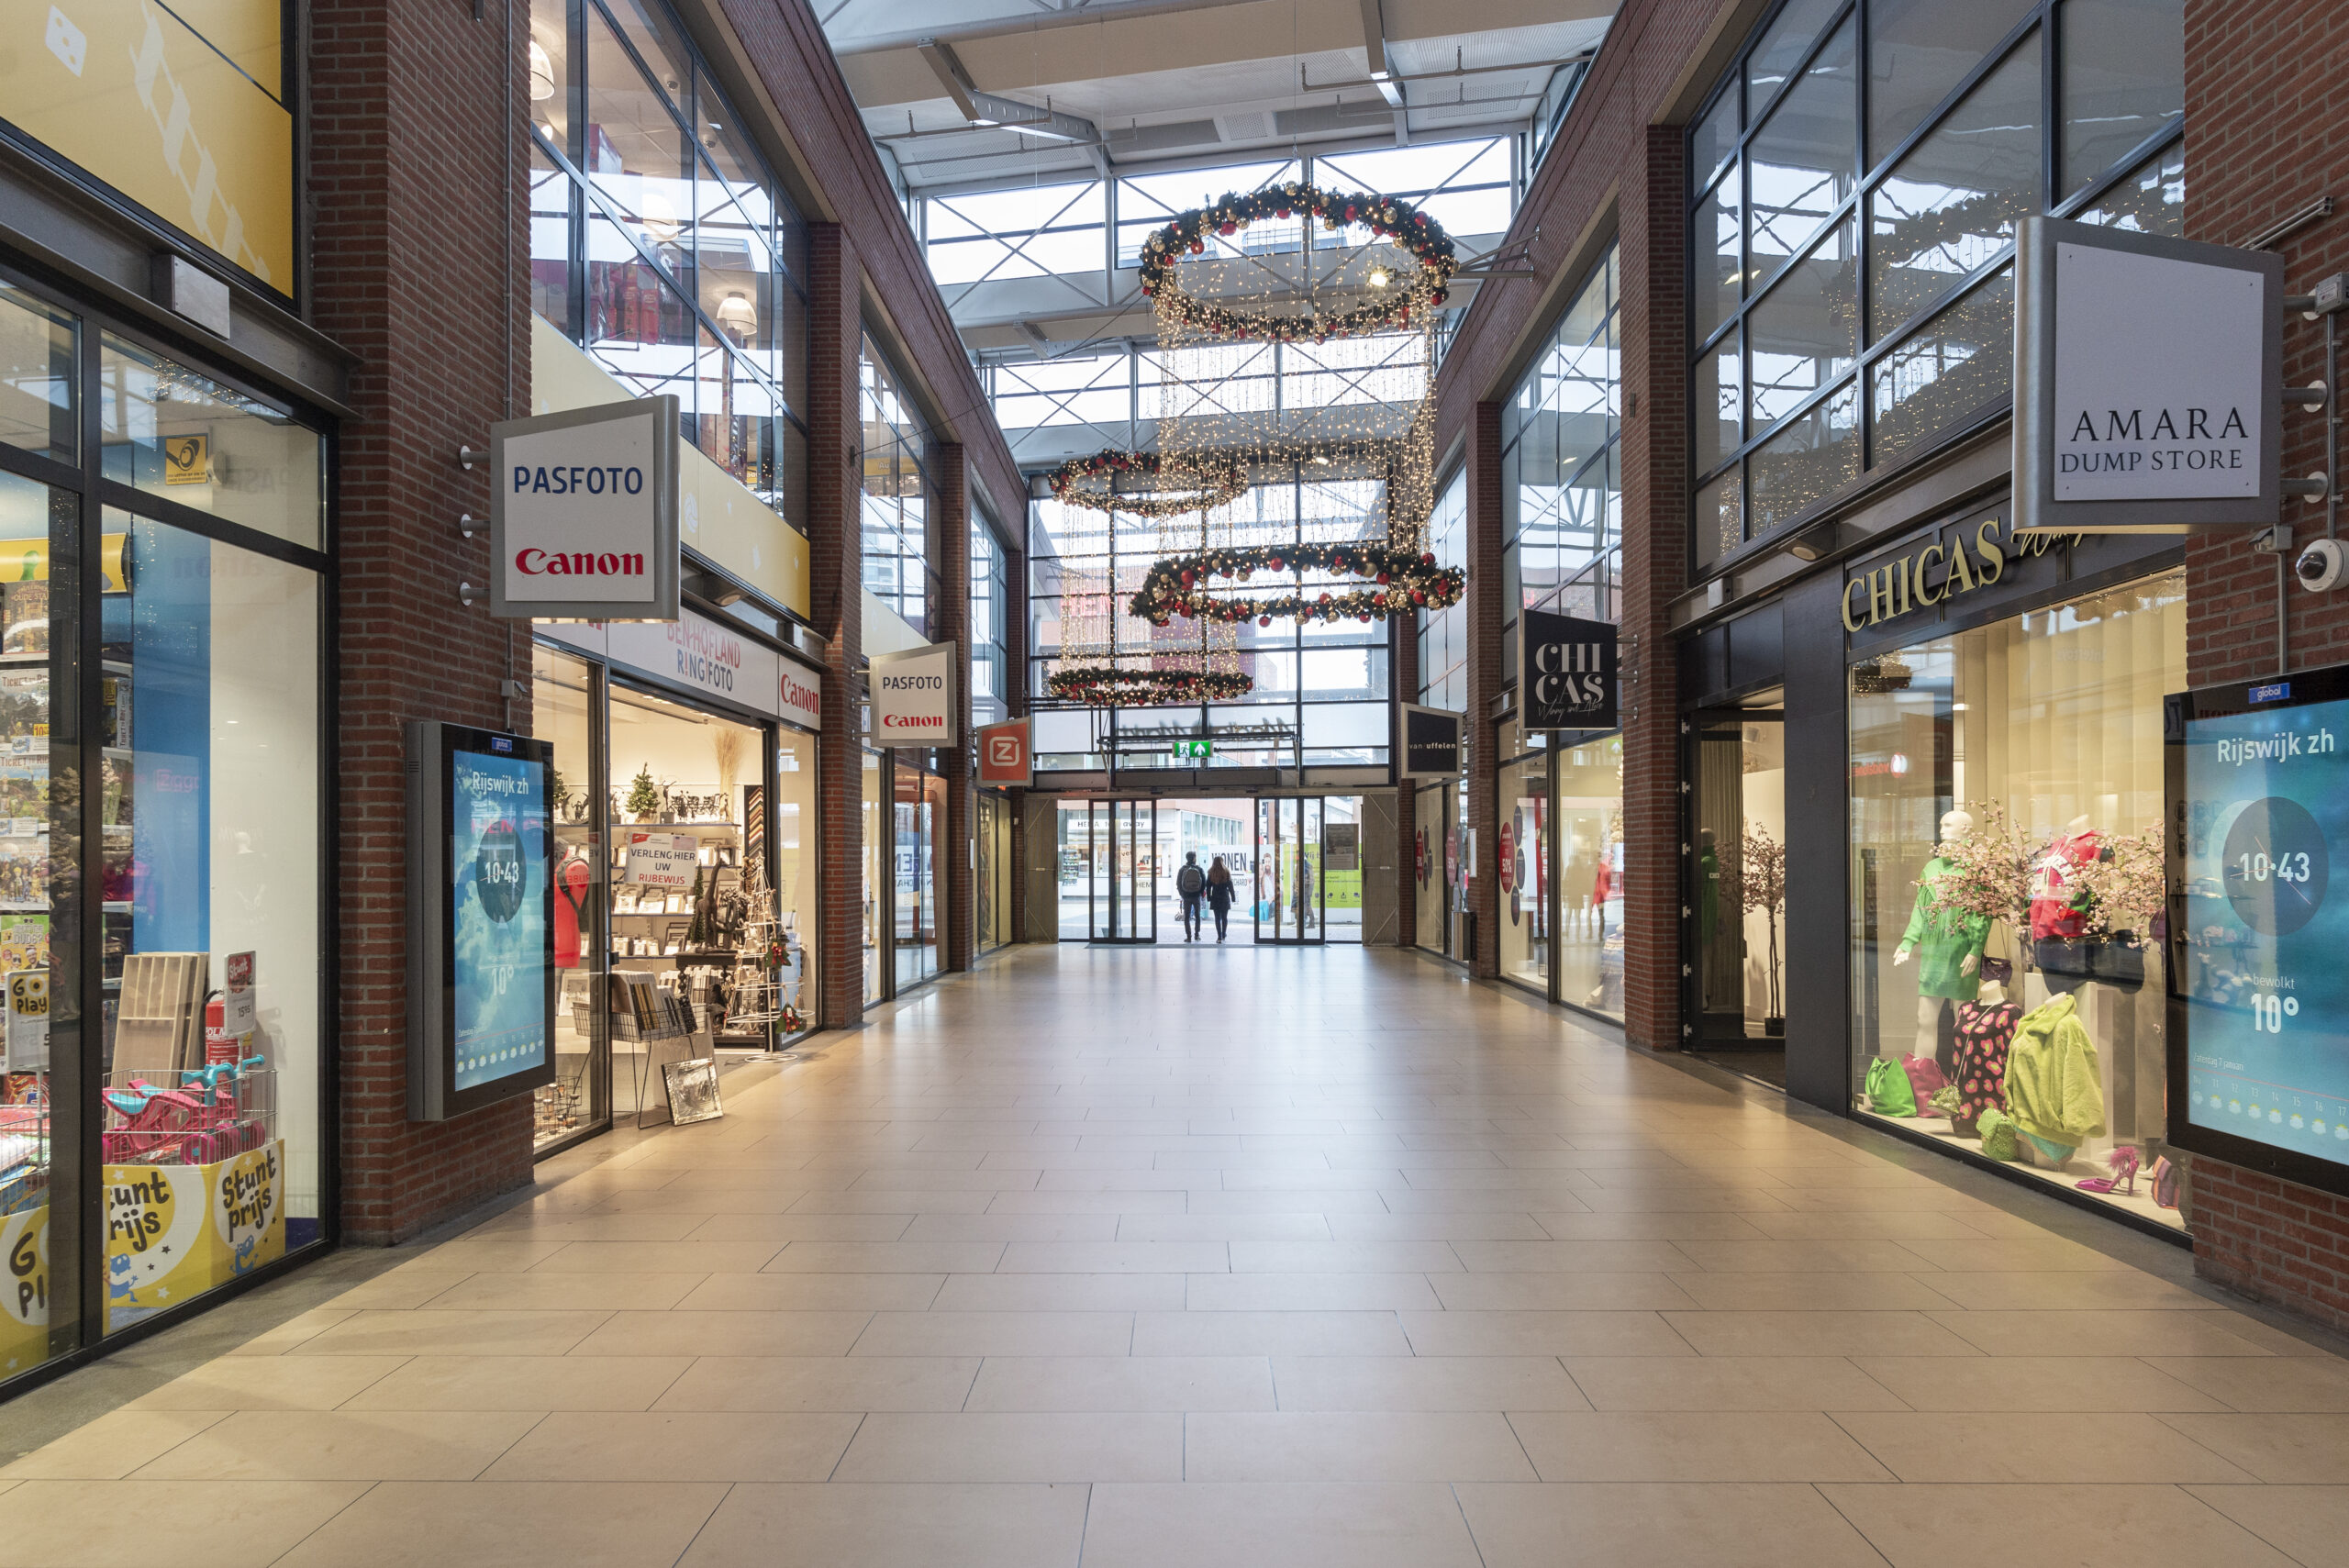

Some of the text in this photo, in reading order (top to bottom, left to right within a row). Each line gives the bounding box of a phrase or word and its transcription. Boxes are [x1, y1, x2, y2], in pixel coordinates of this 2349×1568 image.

[2070, 406, 2249, 441] AMARA
[2060, 450, 2243, 473] DUMP STORE
[514, 466, 643, 495] PASFOTO
[516, 548, 644, 575] Canon
[1842, 517, 2004, 632] CHICAS
[1535, 642, 1604, 673] CHI
[707, 661, 733, 692] FOTO
[883, 676, 942, 690] PASFOTO
[1535, 673, 1604, 704] CAS
[781, 673, 819, 716] Canon
[2257, 686, 2281, 701] global
[884, 714, 942, 728] Canon
[2218, 728, 2334, 766] Rijswijk zh
[473, 771, 529, 796] Rijswijk zh
[631, 848, 696, 861] VERLENG HIER
[655, 862, 672, 871] UW
[639, 873, 685, 884] RIJBEWIJS
[2253, 973, 2296, 990] bewolkt
[2193, 1052, 2218, 1068] Zaterdag
[2338, 1106, 2346, 1117] 17
[108, 1172, 170, 1207] unt
[222, 1150, 276, 1208] Stunt
[229, 1187, 272, 1242] prijs
[110, 1208, 161, 1252] rijs
